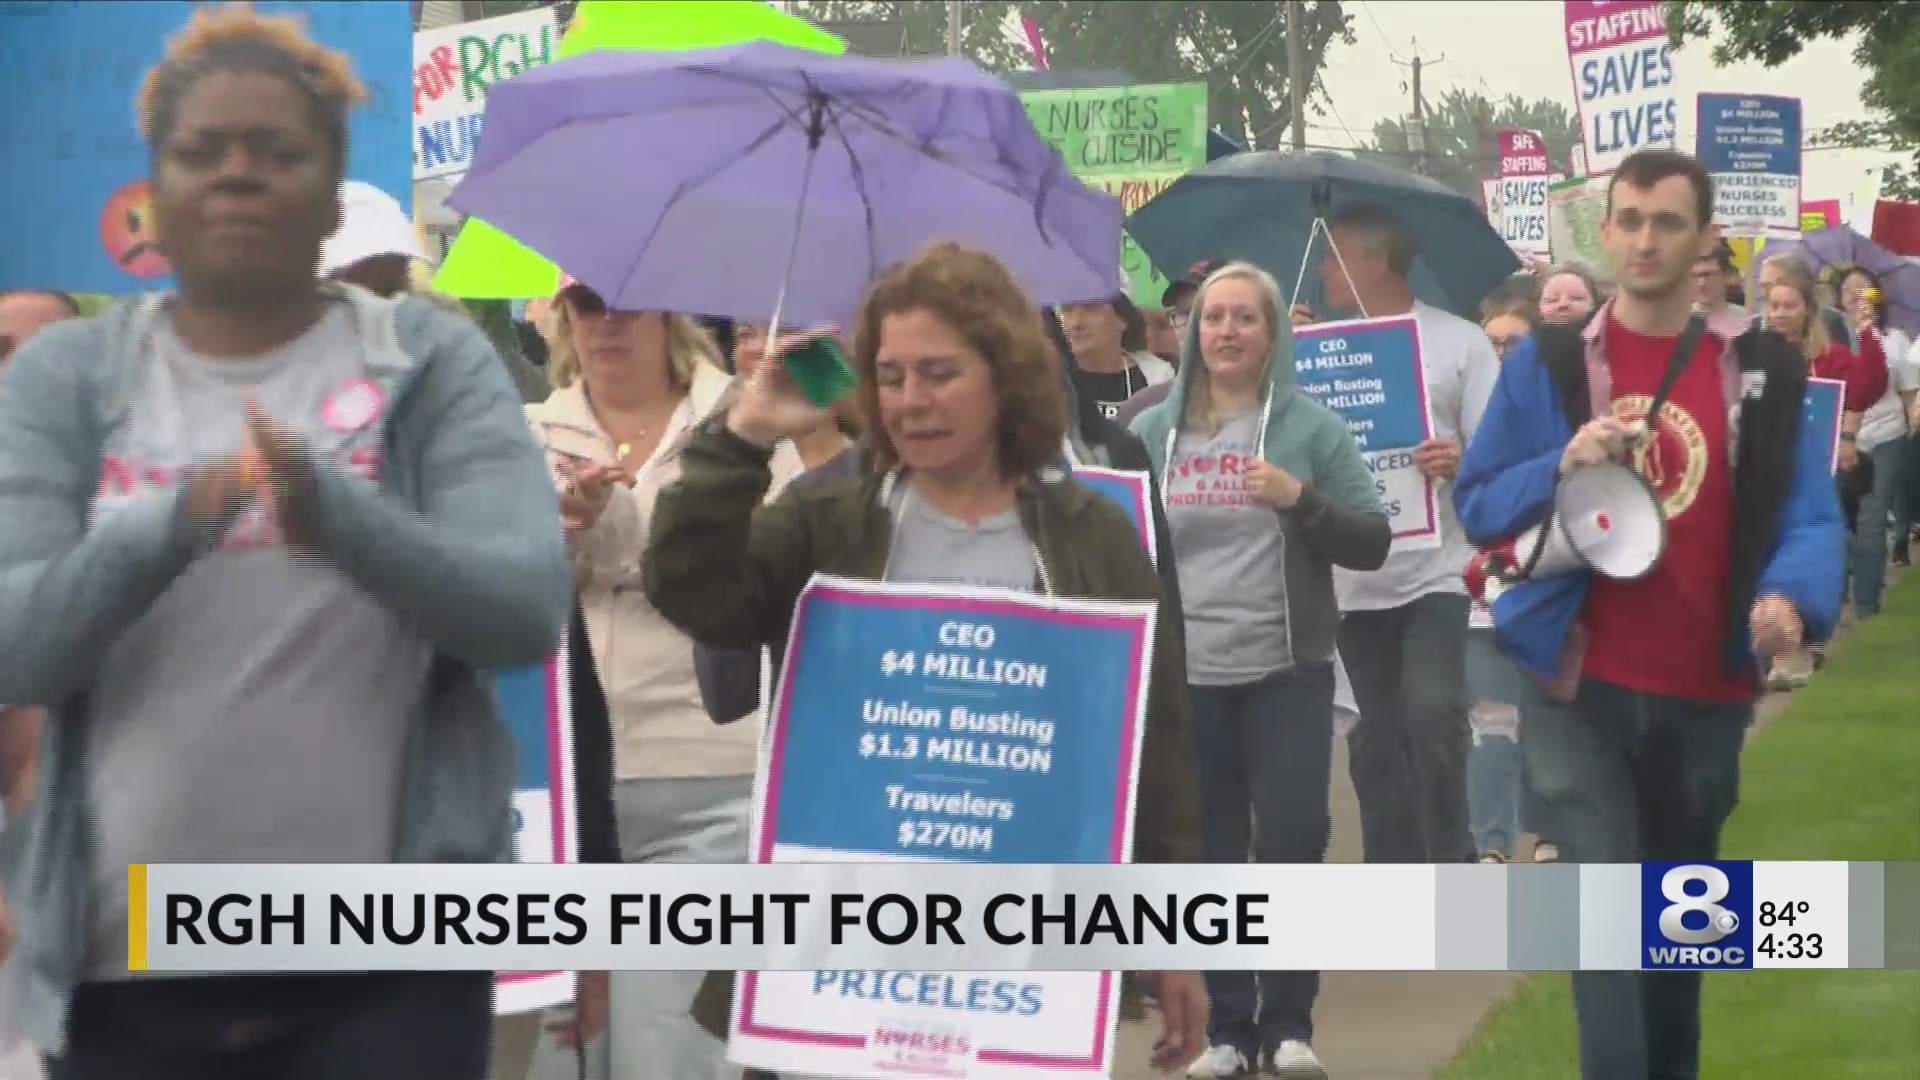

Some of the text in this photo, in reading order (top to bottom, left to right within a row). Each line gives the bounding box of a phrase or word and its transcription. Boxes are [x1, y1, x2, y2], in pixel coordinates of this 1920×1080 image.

[458, 24, 551, 102] RGH
[1581, 42, 1673, 101] SAVES
[1048, 95, 1160, 133] NURSES
[1593, 97, 1677, 151] LIVES
[1511, 133, 1535, 151] SAFE
[1502, 155, 1547, 173] STAFFING
[1504, 180, 1545, 207] SAVES
[1717, 174, 1797, 188] PERIENCED
[1720, 190, 1777, 202] NURSES
[1505, 213, 1545, 241] LIVES
[1319, 339, 1347, 353] CEO
[1315, 352, 1373, 370] MILLION
[1334, 377, 1383, 392] Busting
[1326, 392, 1385, 409] MILLION
[938, 620, 996, 649] CEO
[881, 648, 1047, 689] $4 MILLION
[862, 699, 1055, 746] Union Busting
[858, 732, 1052, 774] $1.3 MILLION
[885, 784, 1015, 820] Travelers
[897, 819, 994, 850] $270M
[812, 970, 1043, 1017] PRICELESS
